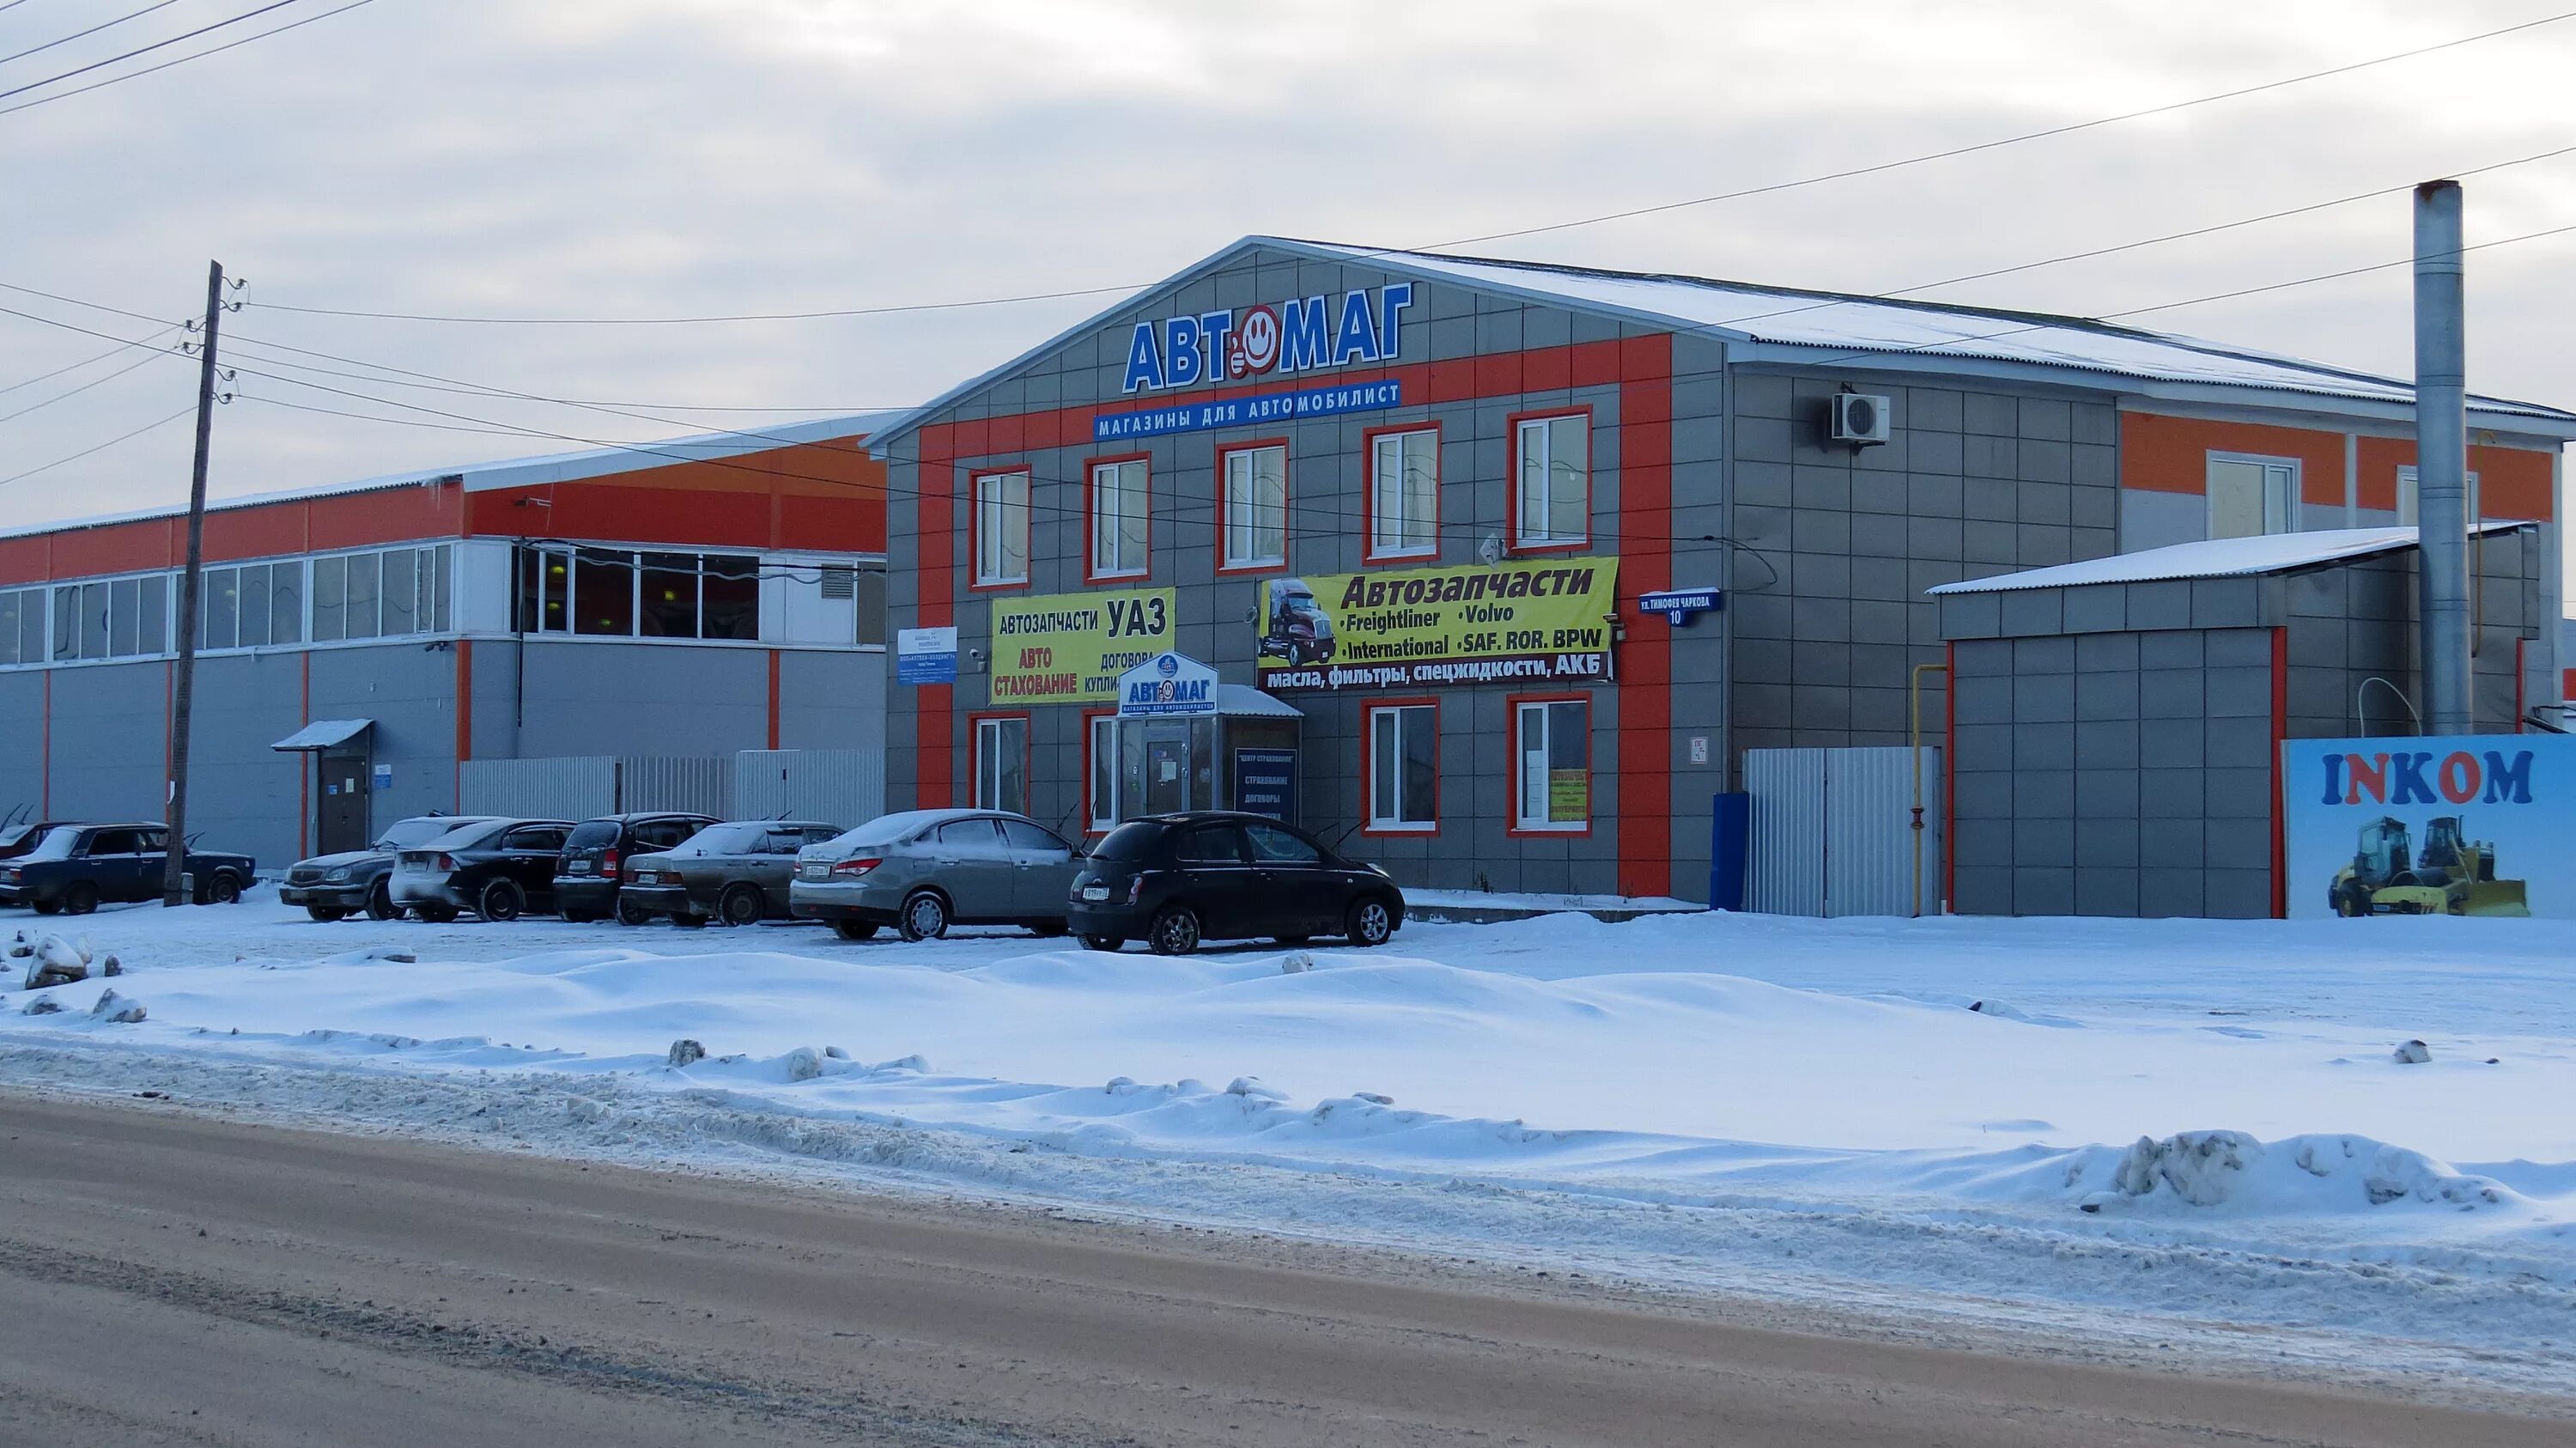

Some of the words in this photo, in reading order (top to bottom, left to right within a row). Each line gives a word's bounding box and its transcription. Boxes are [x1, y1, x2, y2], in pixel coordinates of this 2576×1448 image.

[1098, 410, 1191, 436] МАГАЗИНЫ
[1201, 405, 1236, 426] ДЛЯ
[1249, 384, 1399, 418] АВТОМОБИЛИСТ
[999, 610, 1098, 636] АВТОЗАПЧАСТИ
[1106, 596, 1167, 638] УАЗ
[1650, 598, 1680, 609] ТИМОФЕЯ
[1680, 596, 1710, 607] ЧАРКОВА
[1670, 610, 1681, 624] 10
[1346, 609, 1441, 636] Freightliner
[1465, 603, 1515, 624] Volvo
[1018, 647, 1053, 669] АВТО
[1348, 635, 1449, 660] International
[1552, 629, 1602, 648] BPW
[994, 672, 1078, 697] СТАХОВАНИЕ
[1328, 665, 1410, 690] фильтры,
[1555, 654, 1601, 675] АКБ
[2321, 750, 2535, 806] INKOM
